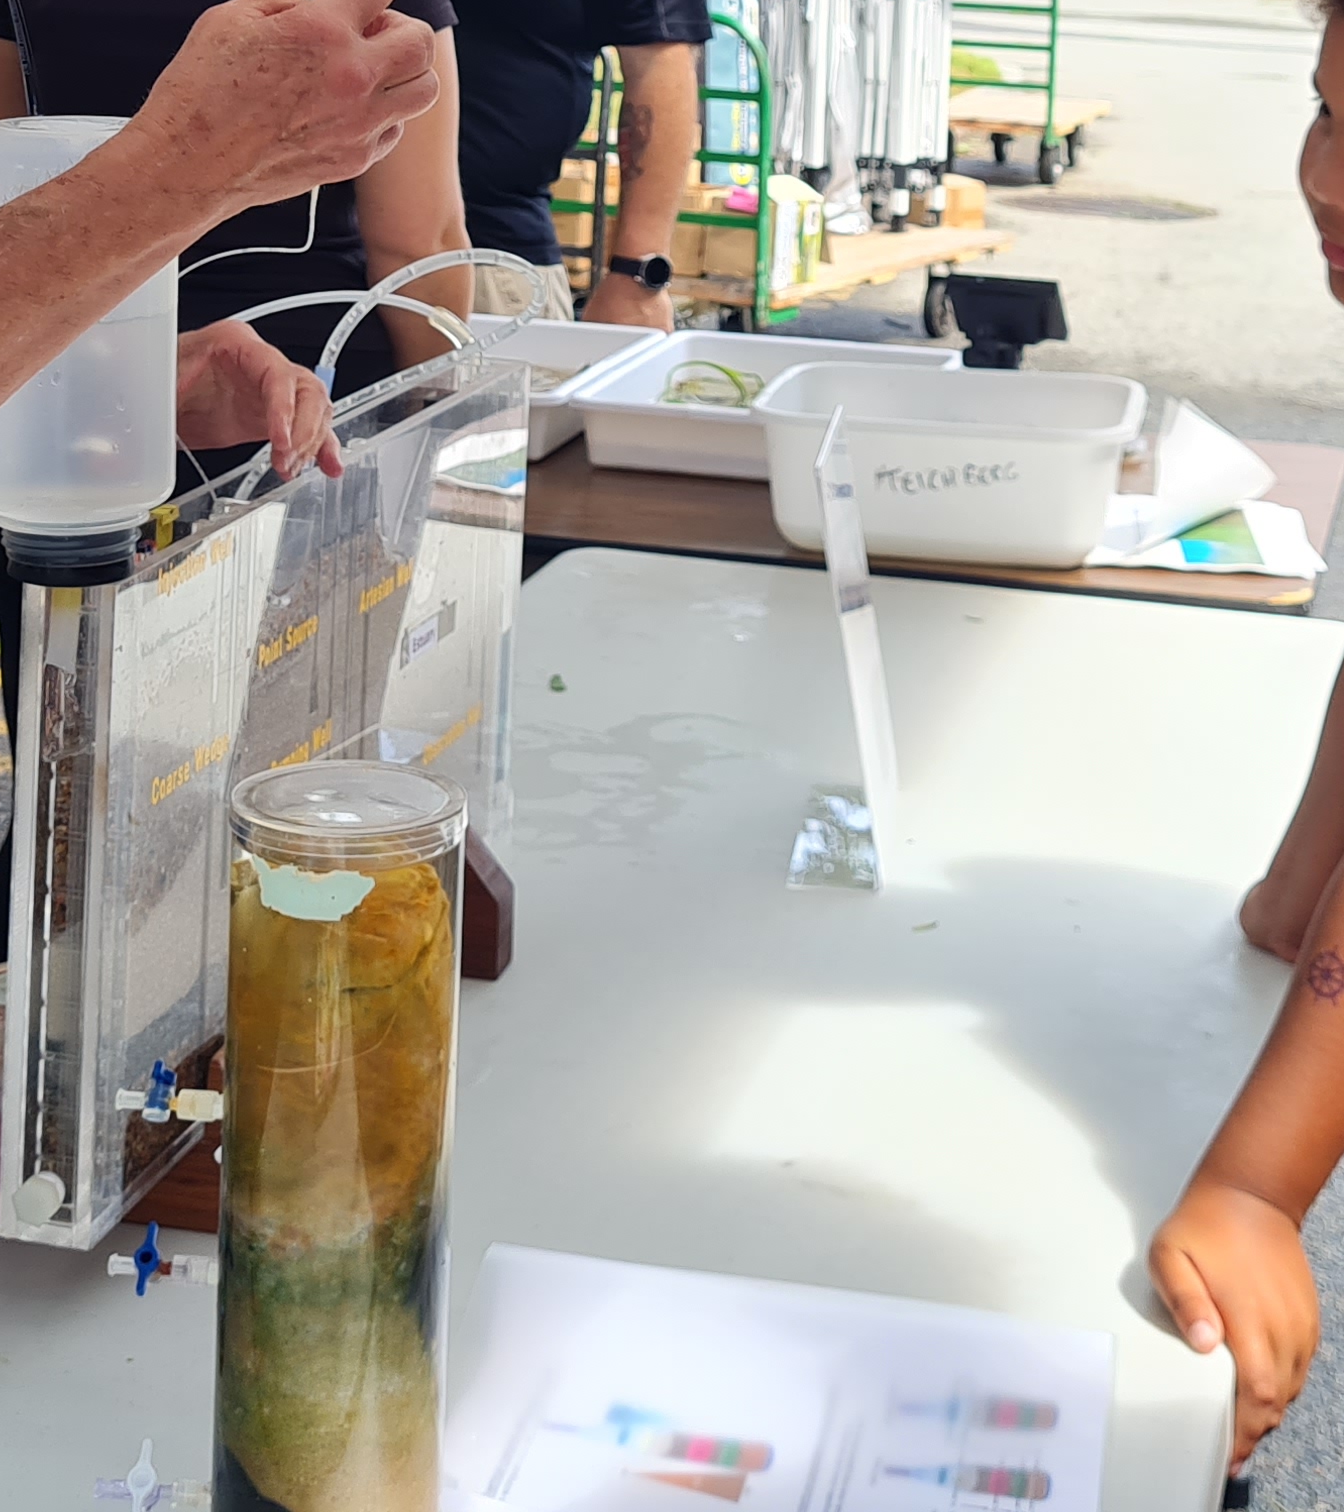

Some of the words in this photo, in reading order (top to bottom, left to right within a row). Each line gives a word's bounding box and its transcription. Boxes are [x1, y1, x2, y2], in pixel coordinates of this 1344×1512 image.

[258, 634, 283, 669] Point
[286, 615, 320, 651] Source
[151, 761, 190, 805] Coarse
[194, 734, 230, 772] Wedge
